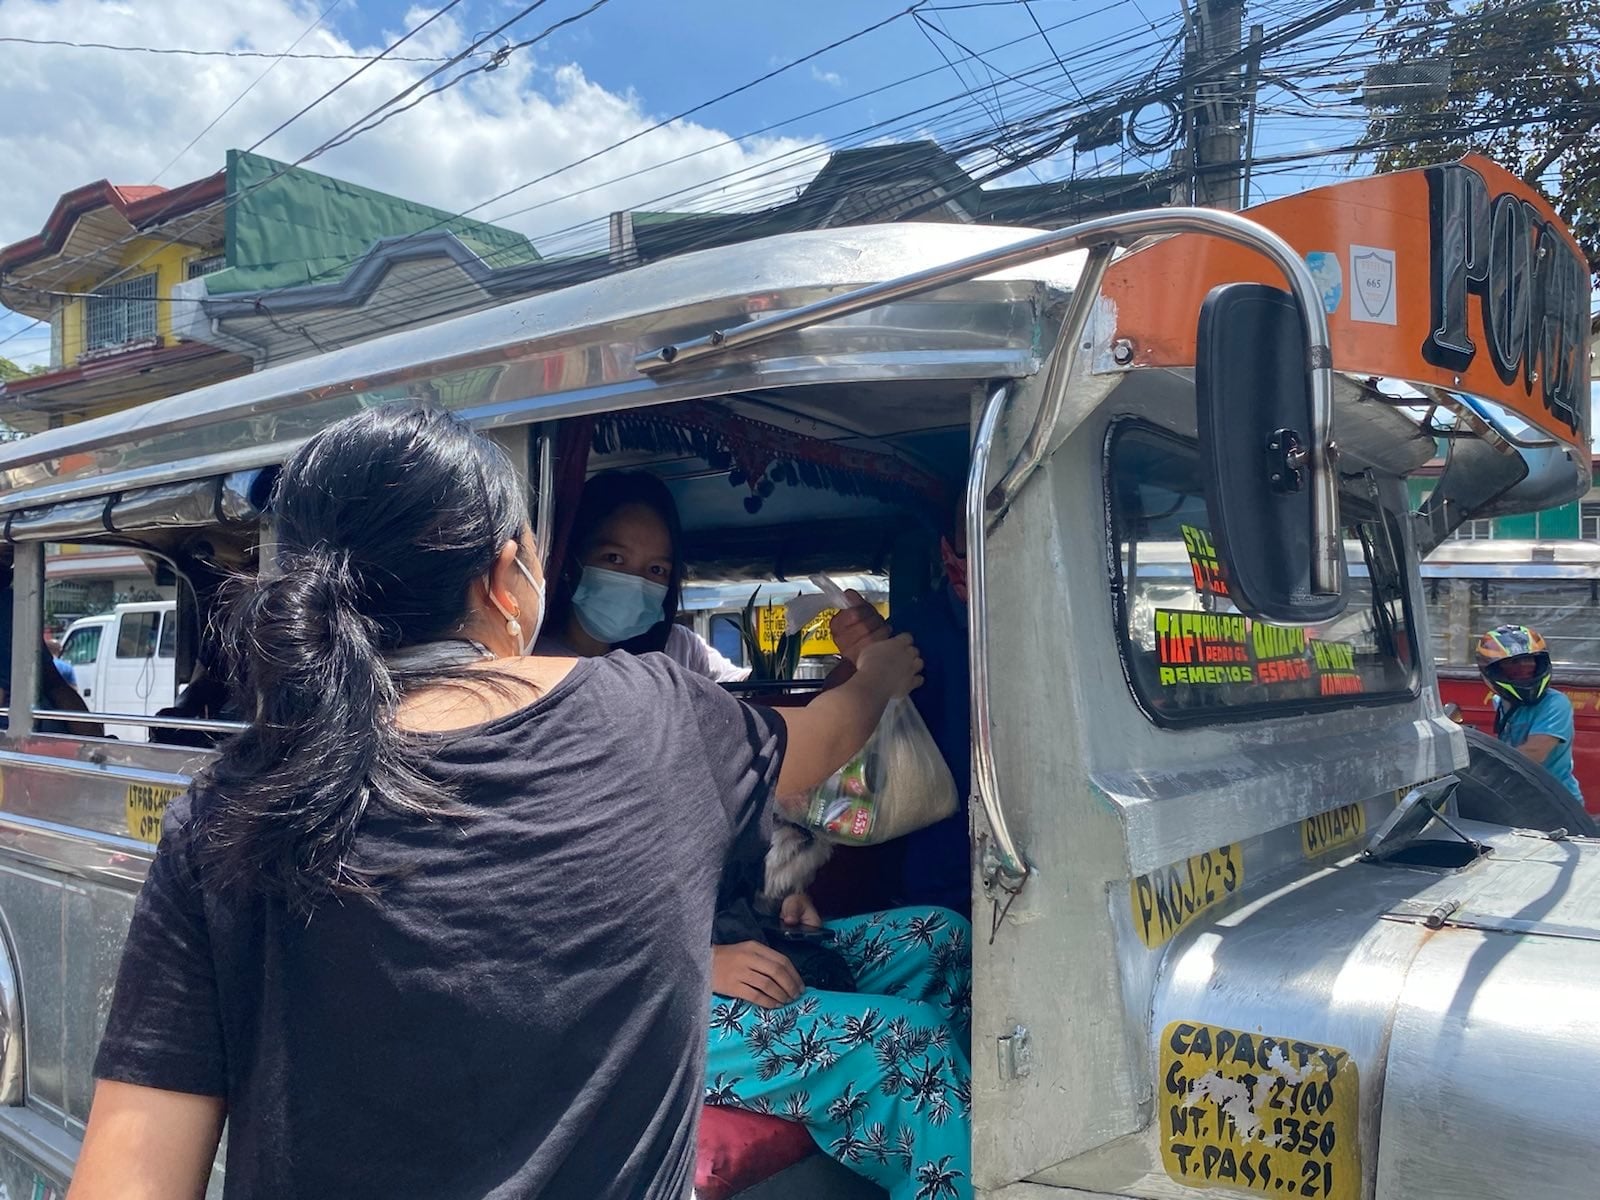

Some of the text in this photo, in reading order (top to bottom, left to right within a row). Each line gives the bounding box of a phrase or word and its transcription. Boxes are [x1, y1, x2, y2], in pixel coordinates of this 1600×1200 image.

[1366, 279, 1381, 288] 665
[1156, 612, 1203, 663] TAFT
[1206, 646, 1233, 662] PEDRO
[1253, 621, 1304, 659] QUIAPO
[1160, 667, 1252, 685] REMEDIOS
[1307, 803, 1360, 850] QUIAPO
[1171, 1023, 1347, 1082] CAPACITY
